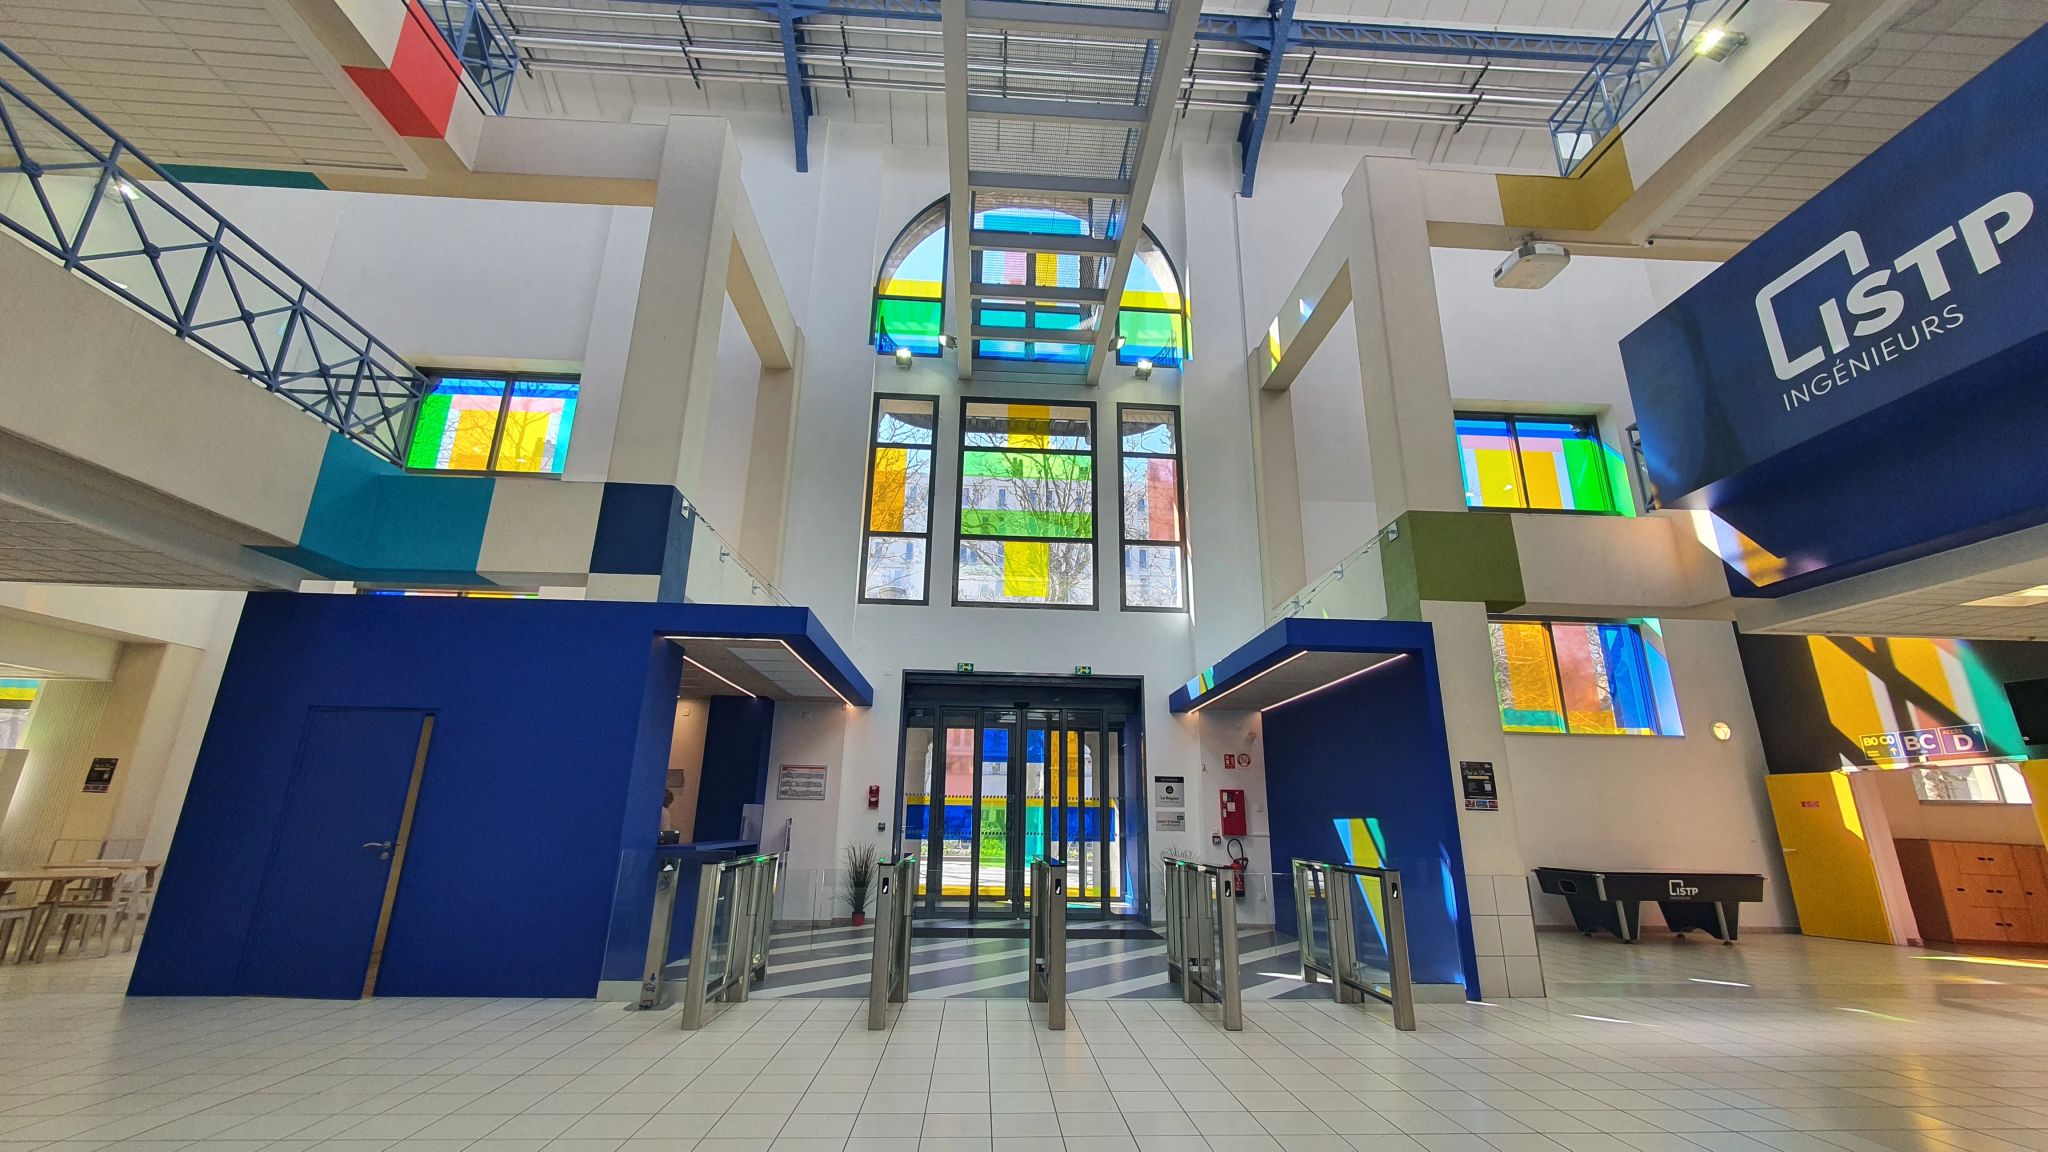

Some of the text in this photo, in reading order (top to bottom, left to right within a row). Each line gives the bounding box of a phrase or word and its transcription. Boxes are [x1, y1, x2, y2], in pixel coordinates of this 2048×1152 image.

[1818, 190, 2035, 355] ISTP
[1782, 302, 1965, 412] INGÉNIEURS
[1903, 733, 1936, 751] BC
[1953, 734, 1974, 751] D
[1676, 887, 1699, 896] ISTP
